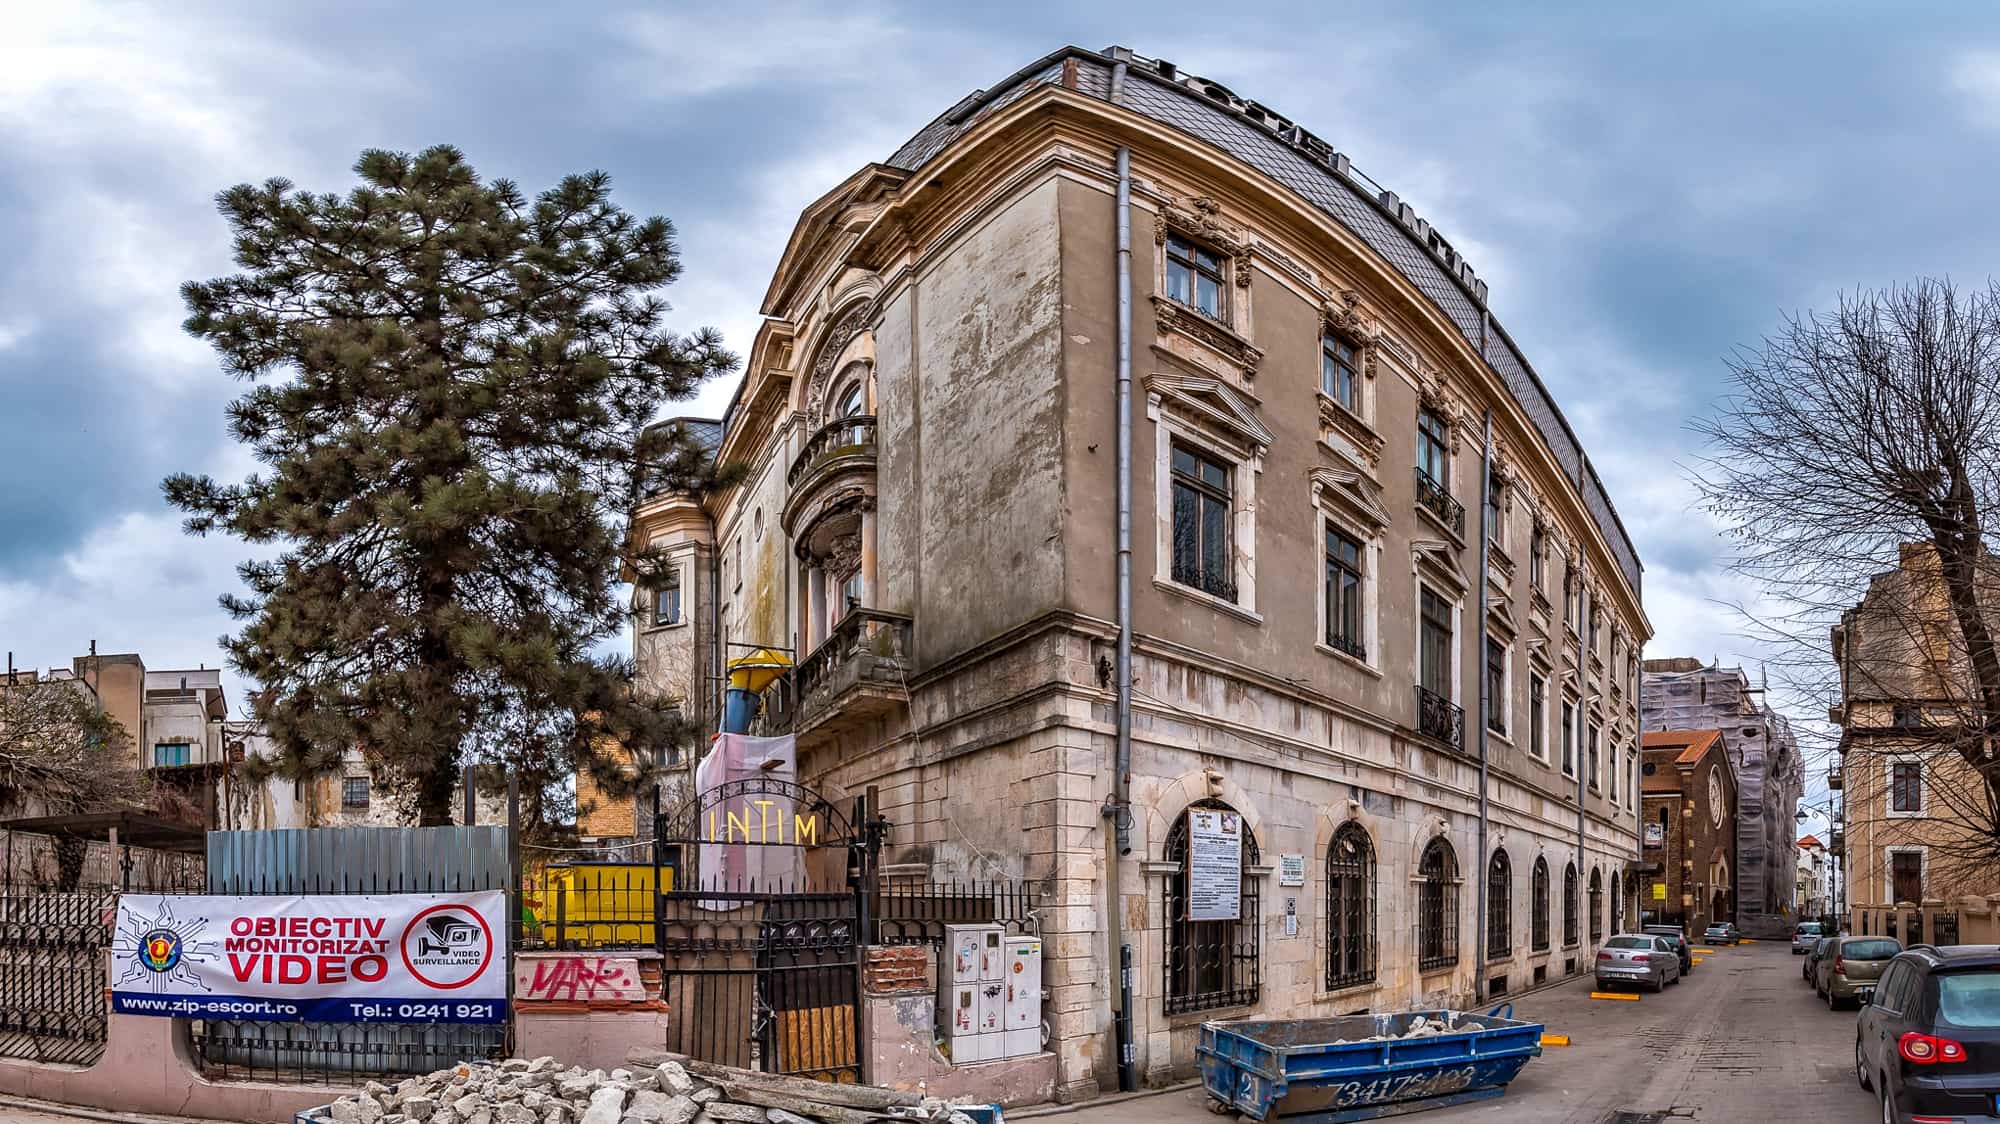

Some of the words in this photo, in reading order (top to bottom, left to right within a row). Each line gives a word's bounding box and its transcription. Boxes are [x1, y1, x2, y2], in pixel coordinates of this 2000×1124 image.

[709, 800, 816, 845] INTIM
[230, 916, 386, 938] OBIECTIV
[225, 938, 390, 954] MONITORIZAT
[453, 950, 480, 958] VIDEO
[227, 953, 389, 984] VIDEO
[413, 958, 481, 966] SURVEILLANCE
[121, 998, 297, 1014] www.zip-escort.ro
[350, 1004, 392, 1017] Tel.:
[399, 1004, 449, 1018] 0241
[456, 1004, 493, 1018] 921
